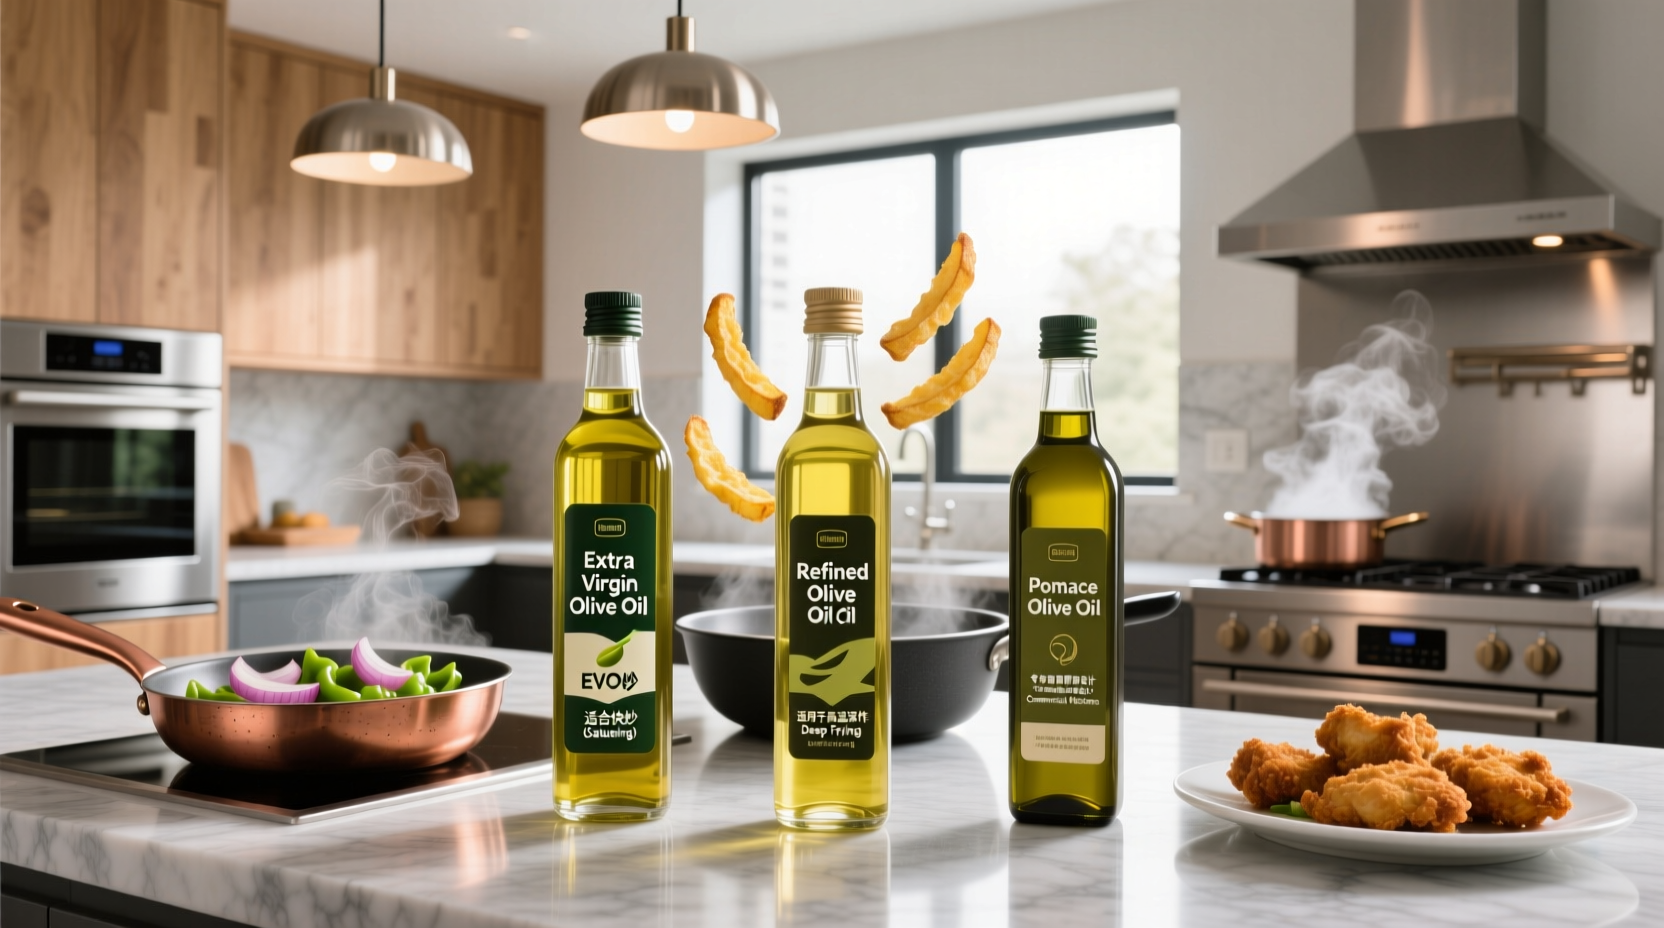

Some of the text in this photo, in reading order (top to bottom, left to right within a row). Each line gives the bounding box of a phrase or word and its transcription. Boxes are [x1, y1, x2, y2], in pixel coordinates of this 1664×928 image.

[584, 551, 635, 569] Extra
[796, 561, 869, 580] Refined
[581, 573, 638, 597] Virgin
[806, 584, 857, 603] Olive
[1028, 576, 1098, 595] Pomace
[569, 595, 648, 616] Olive Oil
[807, 605, 833, 624] Oil
[1027, 598, 1101, 616] Olive Oil
